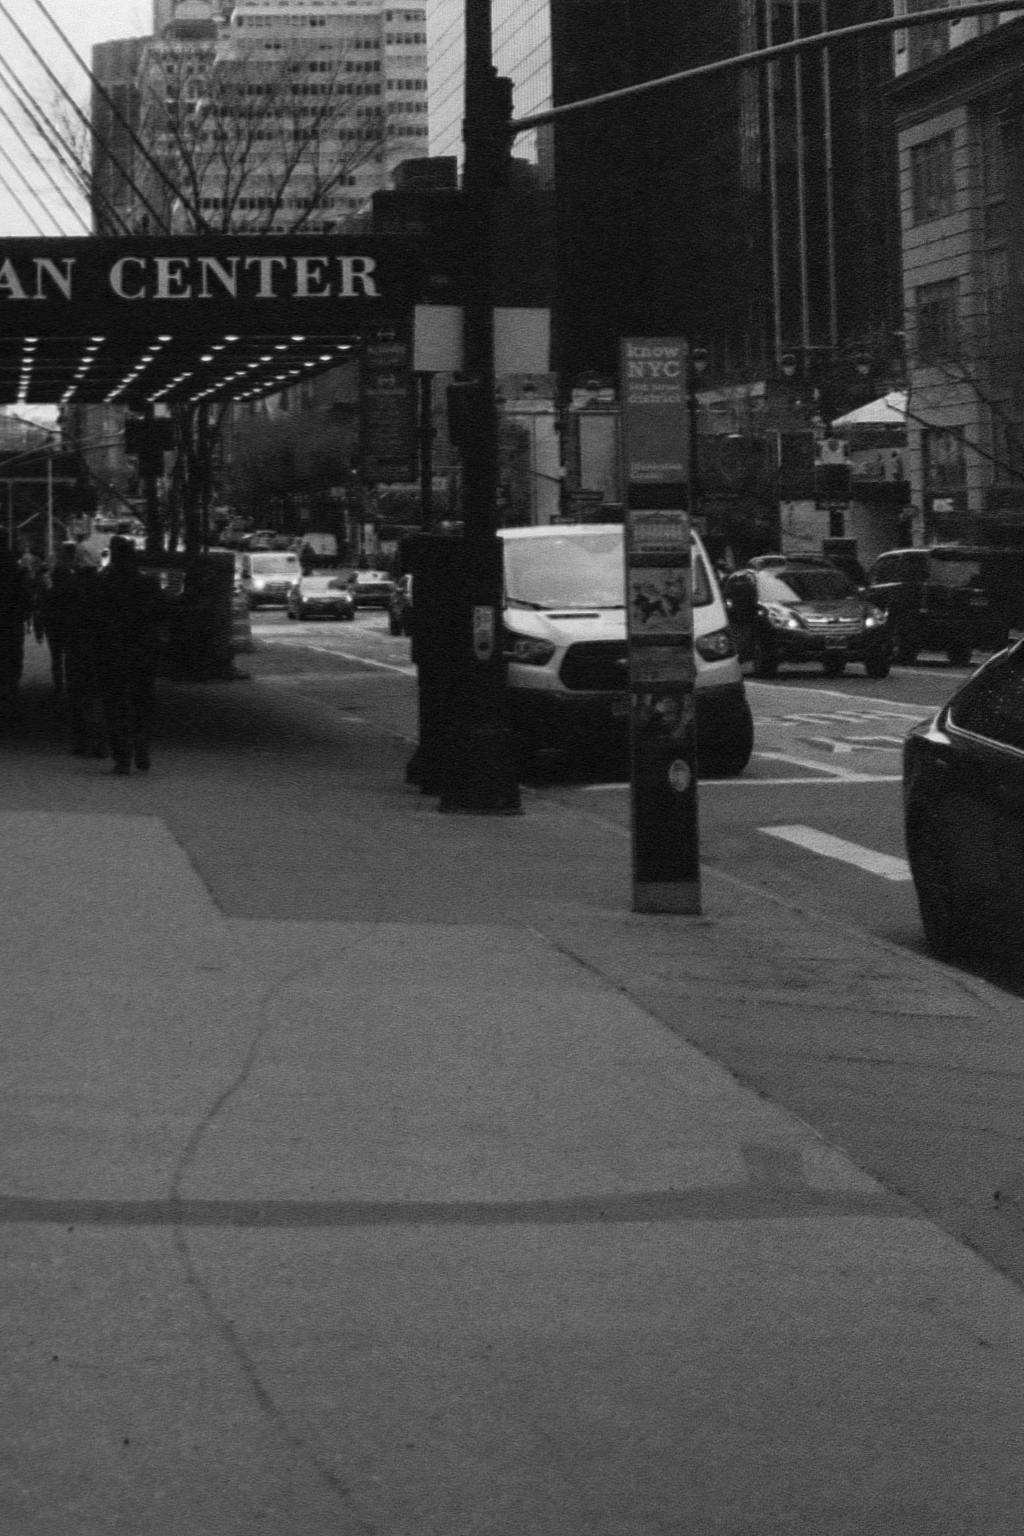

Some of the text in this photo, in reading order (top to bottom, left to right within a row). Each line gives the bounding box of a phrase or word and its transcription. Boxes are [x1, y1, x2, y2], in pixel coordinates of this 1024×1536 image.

[109, 254, 382, 300] CENTER
[626, 342, 680, 358] know
[627, 360, 681, 378] NYC
